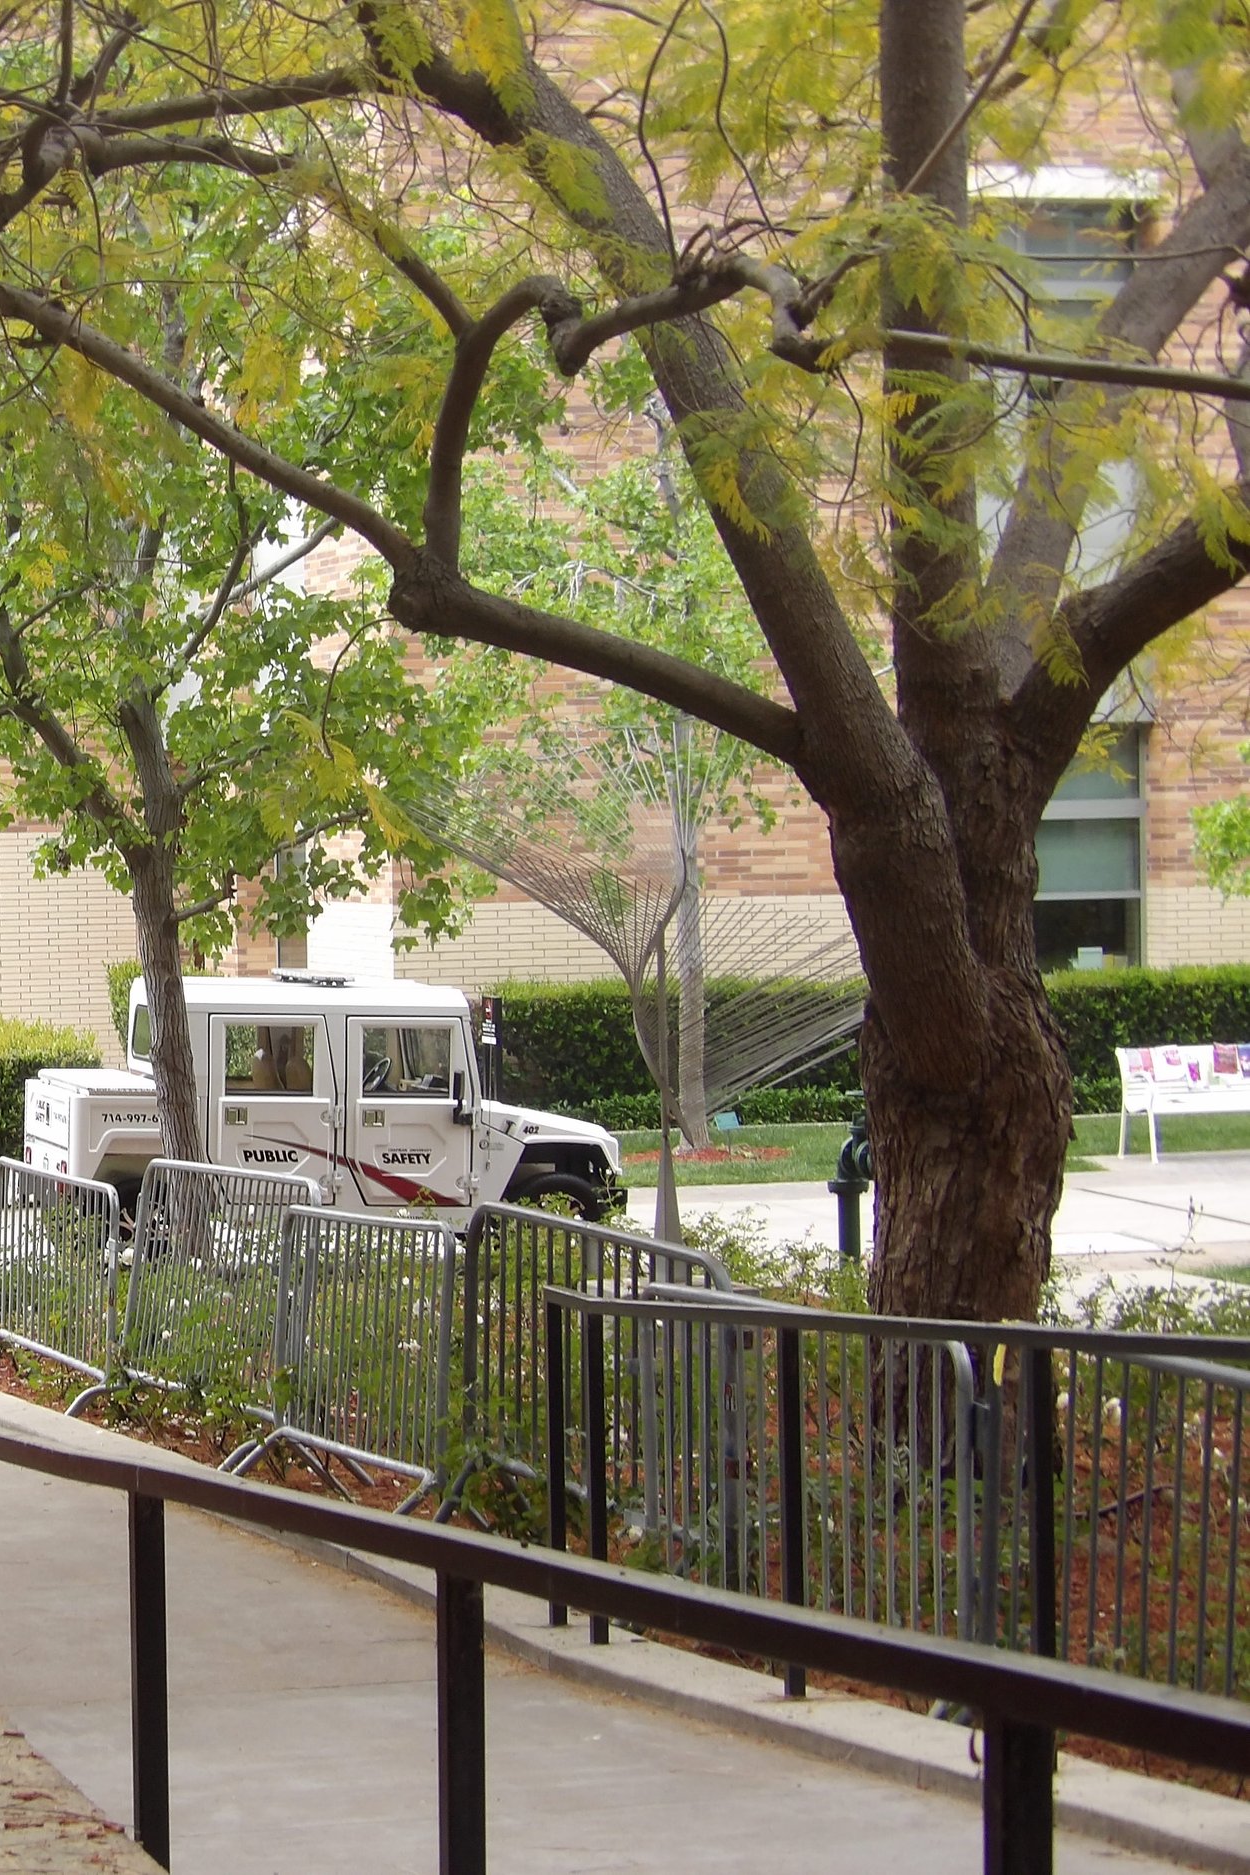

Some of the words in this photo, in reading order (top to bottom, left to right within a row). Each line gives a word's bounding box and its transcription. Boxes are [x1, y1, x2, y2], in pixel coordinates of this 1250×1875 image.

[101, 1113, 160, 1123] 714-997-6
[523, 1126, 539, 1134] 402
[243, 1150, 299, 1163] PUBLIC
[382, 1153, 431, 1164] SAFETY
